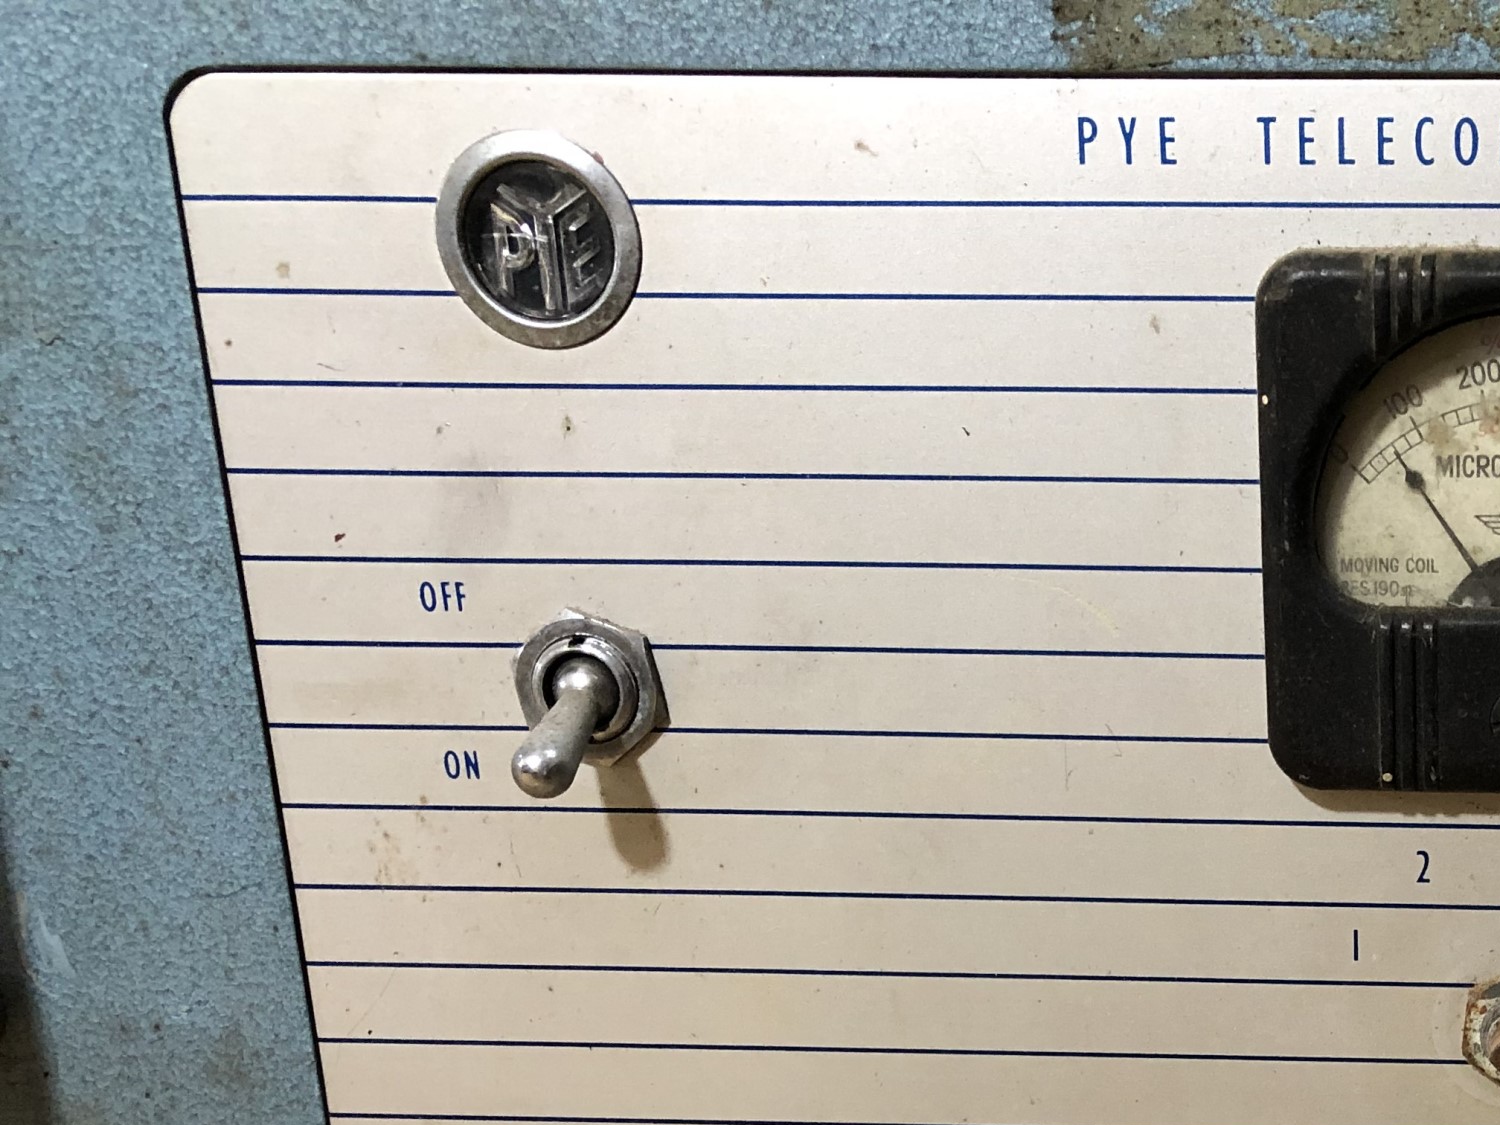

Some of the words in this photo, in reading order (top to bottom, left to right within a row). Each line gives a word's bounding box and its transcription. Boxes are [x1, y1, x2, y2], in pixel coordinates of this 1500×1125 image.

[1076, 116, 1179, 165] PYE
[489, 182, 604, 312] PYE
[1383, 384, 1424, 420] 100
[1340, 556, 1400, 574] MOVING
[1405, 557, 1440, 574] COIL
[419, 581, 466, 612] OFF
[443, 750, 481, 780] ON
[1415, 850, 1431, 884] 2
[1353, 929, 1359, 962] 1
